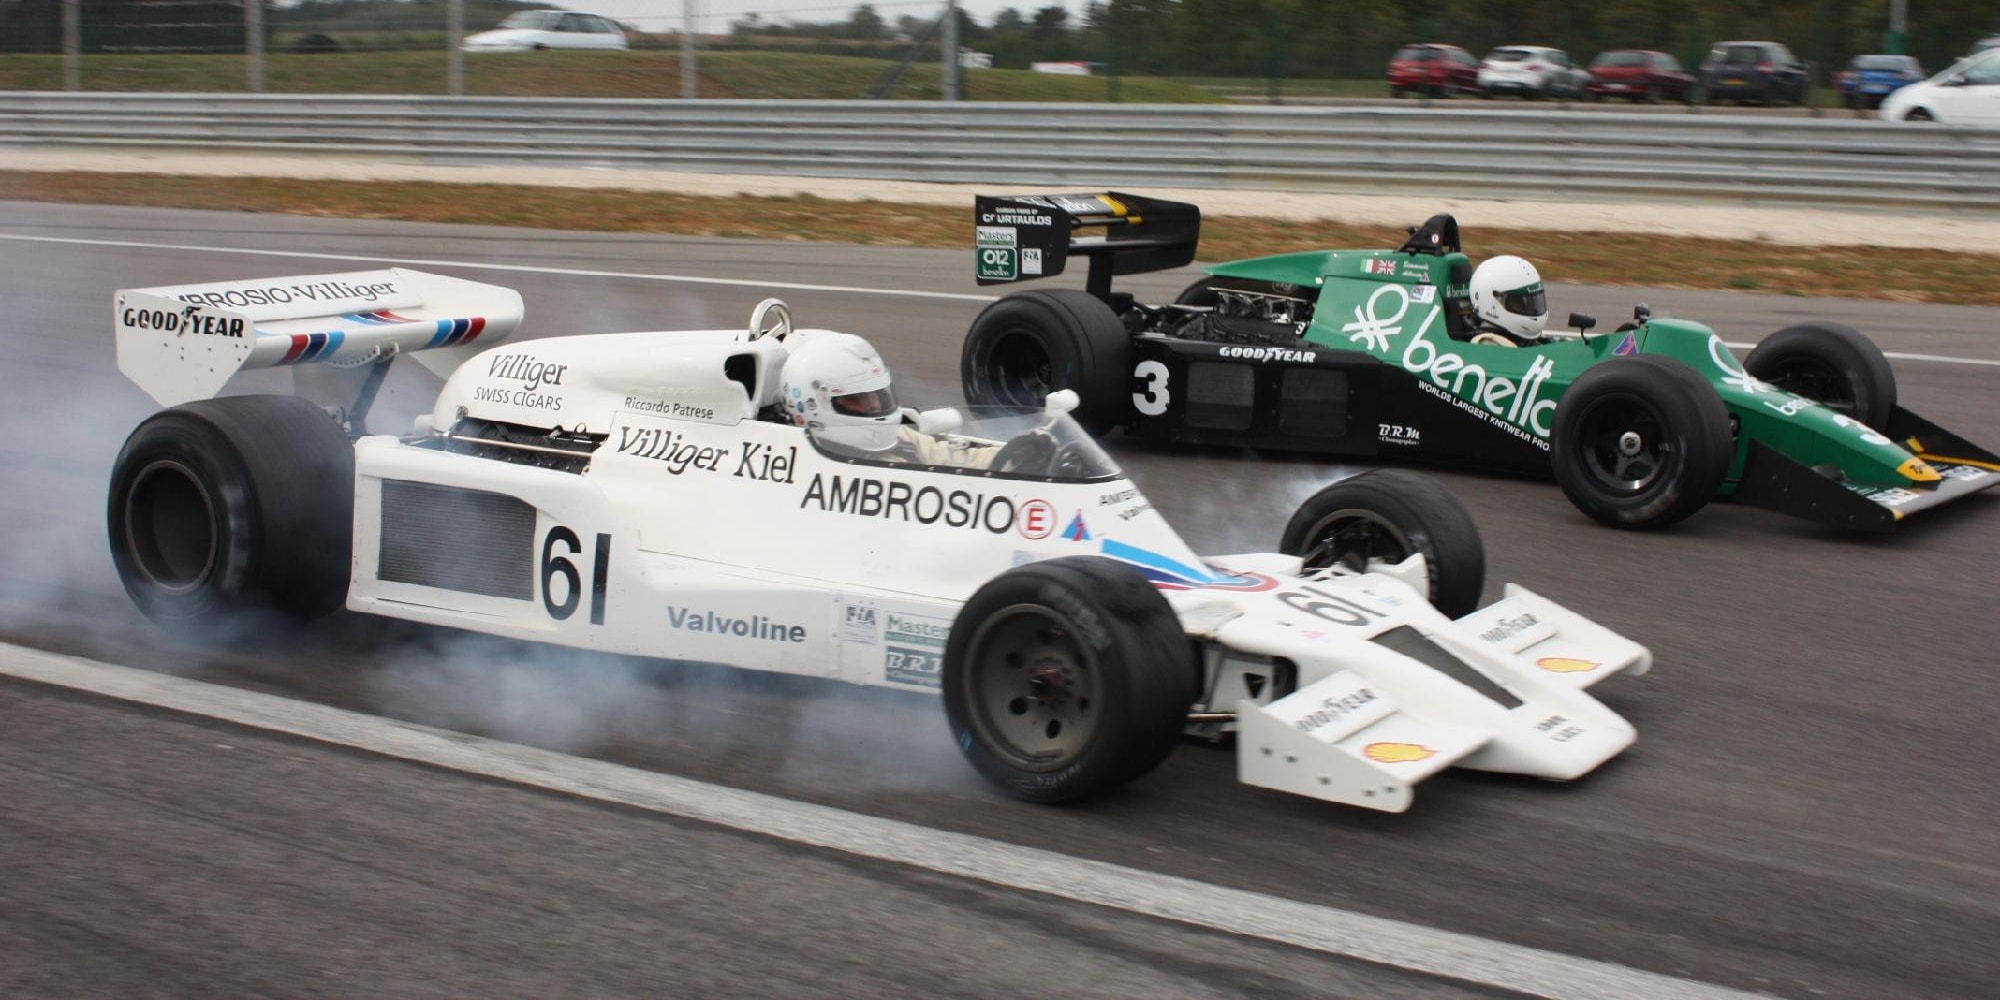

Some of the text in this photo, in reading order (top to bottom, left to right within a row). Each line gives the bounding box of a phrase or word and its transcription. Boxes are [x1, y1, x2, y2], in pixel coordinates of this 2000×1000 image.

[123, 306, 245, 338] GOODYEAR
[489, 354, 568, 391] Villiger
[1219, 346, 1317, 363] GOODYEAR
[473, 386, 563, 412] SWISS CIGARS
[1132, 360, 1170, 416] 3
[624, 397, 714, 420] Riccardo Patrese
[1418, 379, 1551, 451] WORLDS LARGEST KNITWEAR PRO
[616, 426, 797, 484] Villiger Kiel
[800, 473, 1015, 534] AMBROSIO
[541, 525, 612, 626] 61
[667, 606, 807, 643] Valvoline
